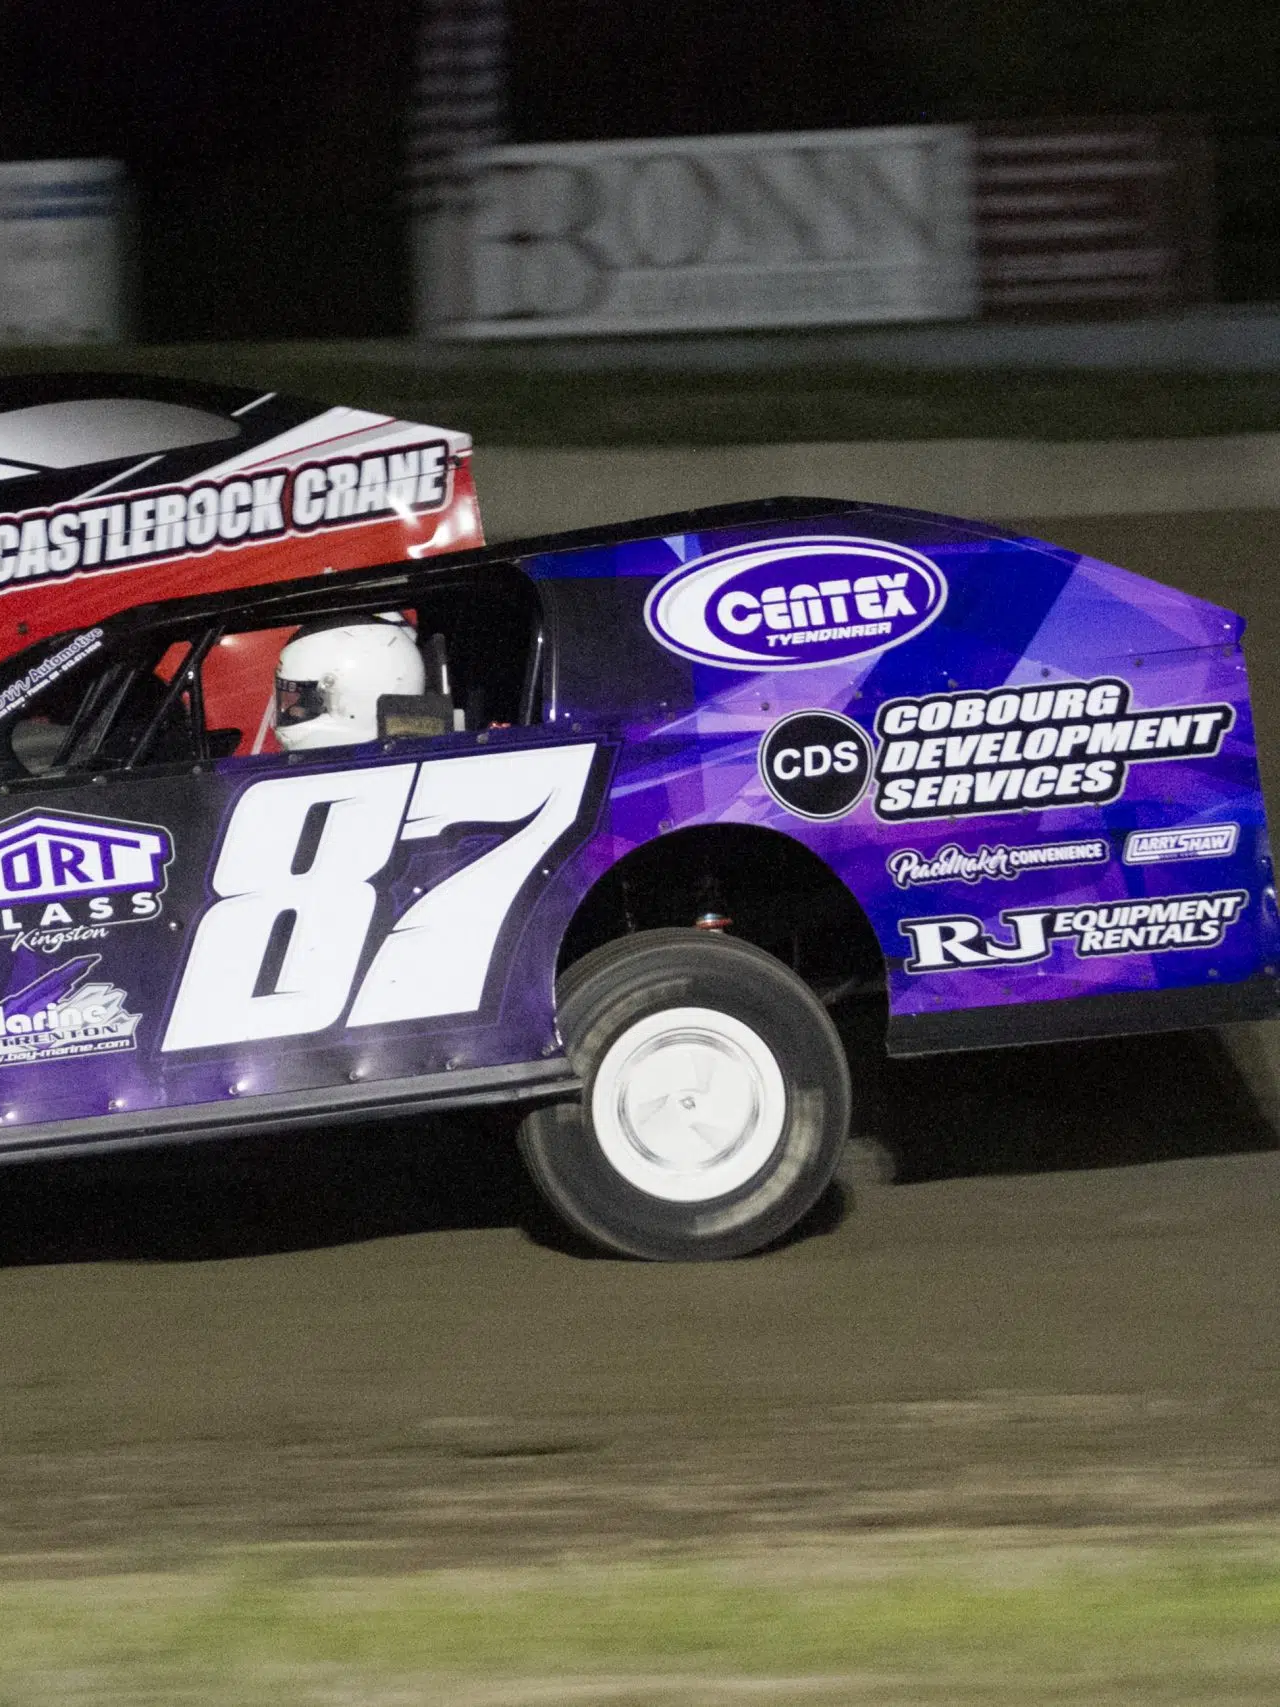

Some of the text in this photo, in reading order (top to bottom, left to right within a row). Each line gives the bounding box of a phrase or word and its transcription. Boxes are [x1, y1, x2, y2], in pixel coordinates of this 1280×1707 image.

[293, 448, 445, 526] CRANE
[29, 628, 104, 684] Automotive
[766, 621, 892, 649] TYENDINAGA
[883, 684, 1123, 736] COBOURG
[773, 741, 860, 781] CDS
[880, 712, 1226, 775] DEVELOPMENT
[879, 761, 1116, 813] SERVICES
[1010, 842, 1104, 866] CONVENIENCE
[160, 742, 596, 1052] 87
[1054, 896, 1241, 933] EQUIPMENT
[11, 924, 109, 952] Kingston
[905, 912, 1051, 968] RJ
[1080, 920, 1222, 951] RENTALS
[1, 1023, 119, 1046] TRENTON
